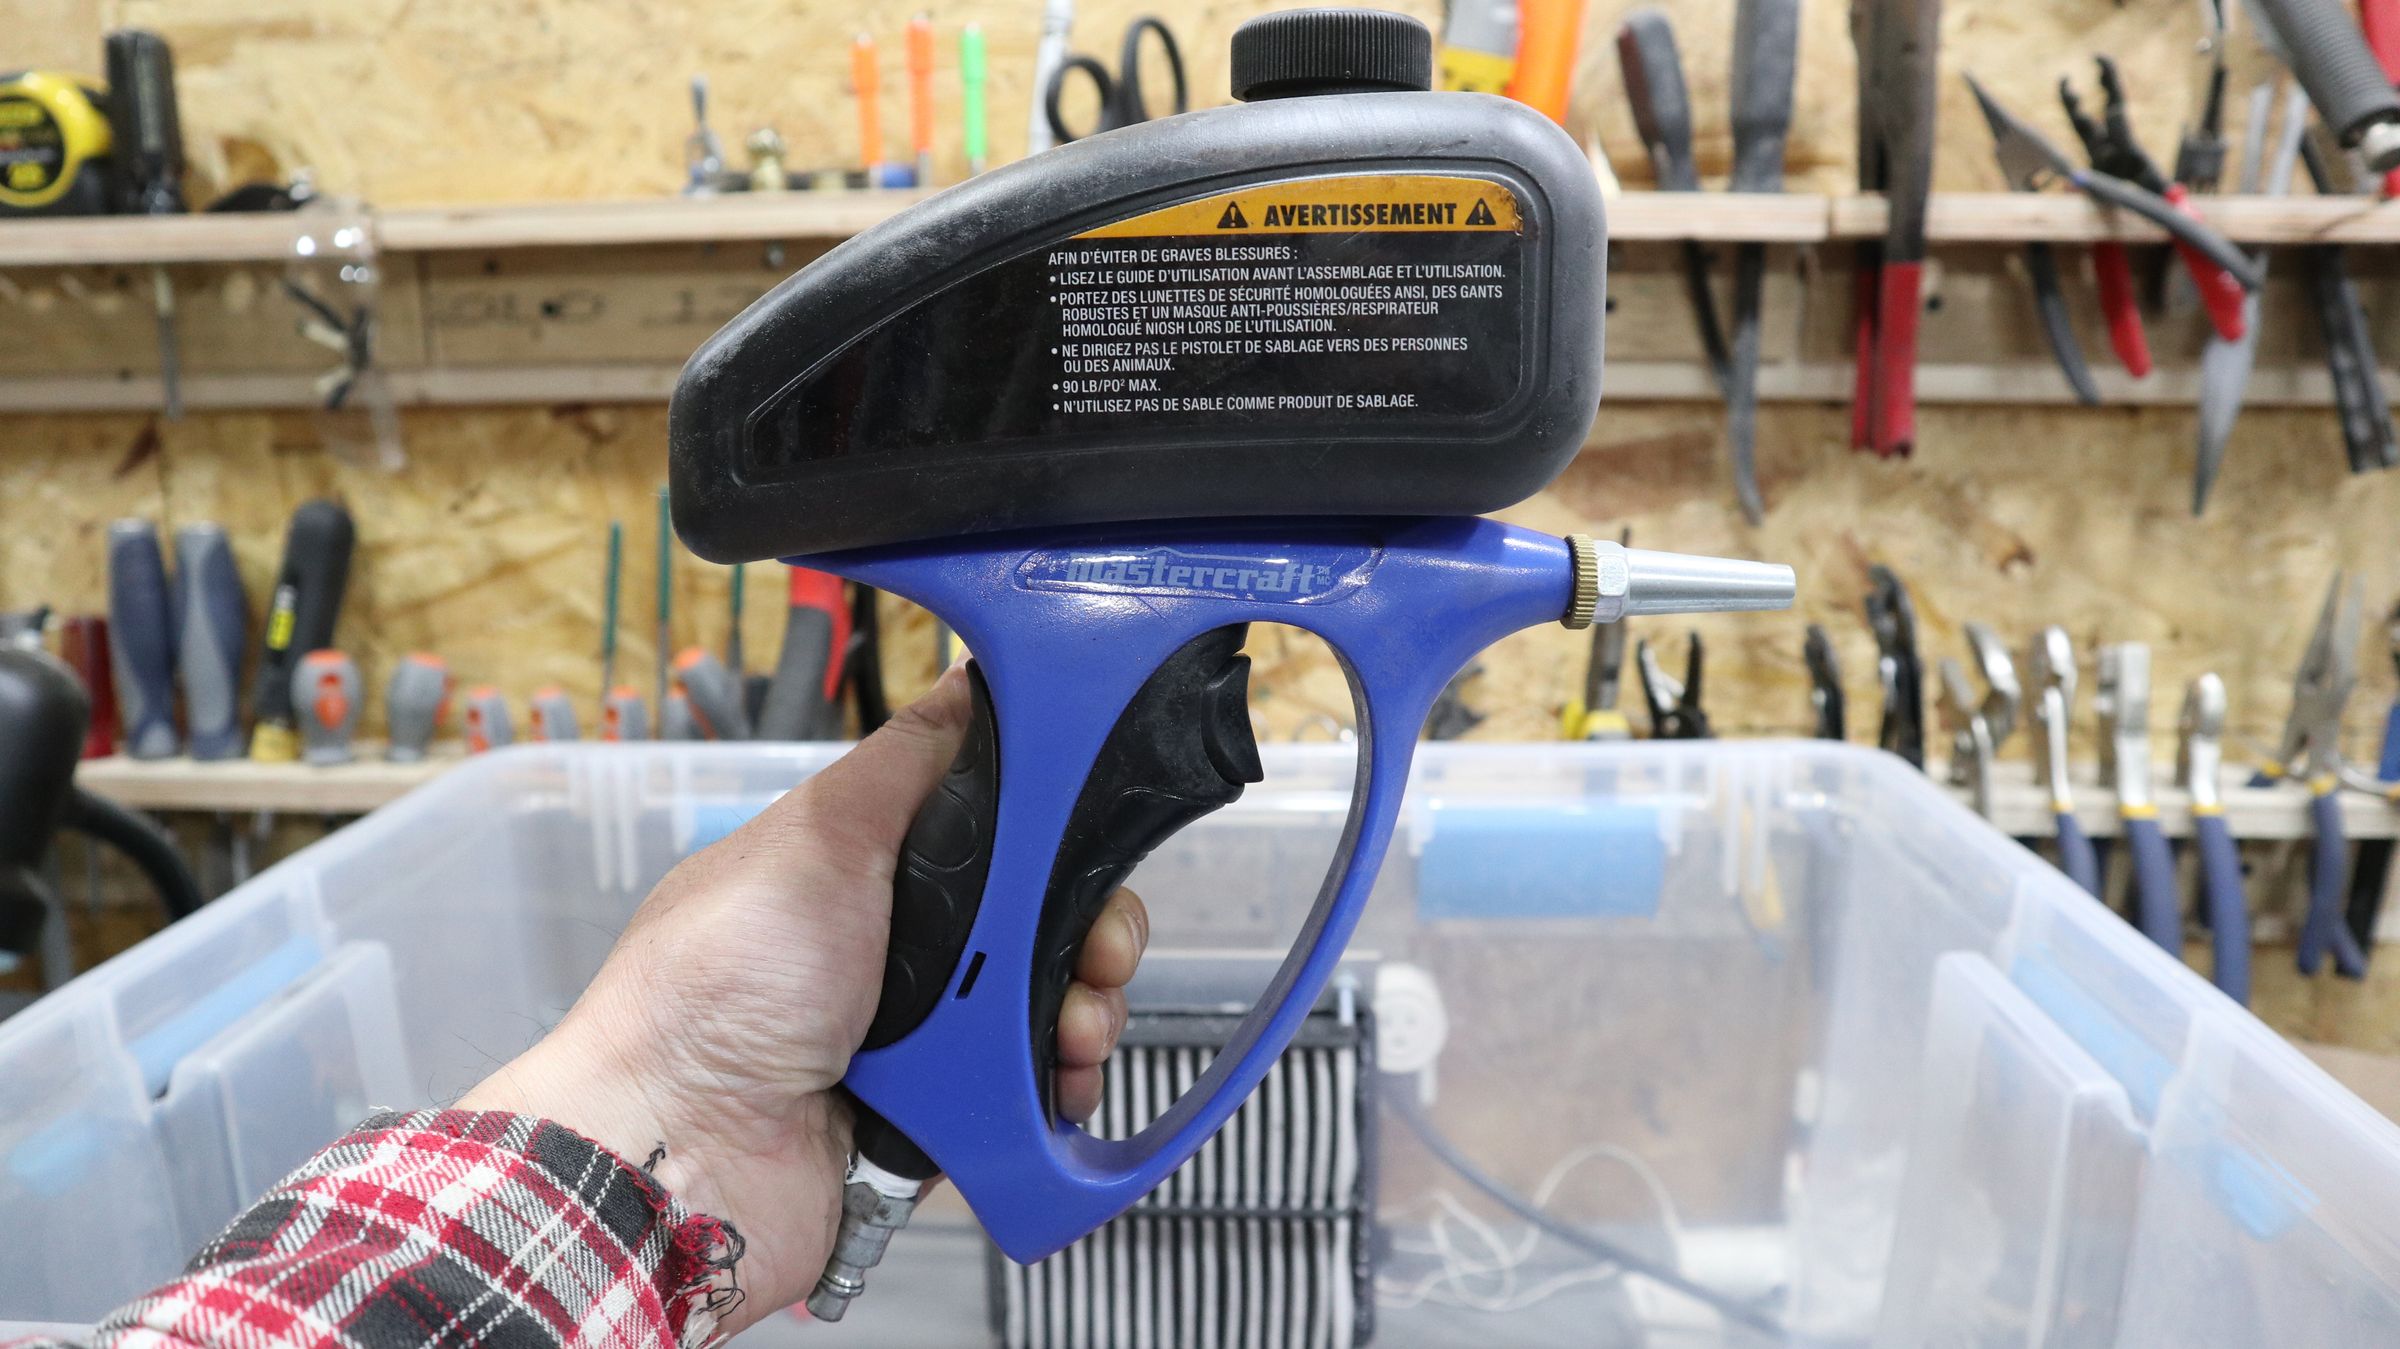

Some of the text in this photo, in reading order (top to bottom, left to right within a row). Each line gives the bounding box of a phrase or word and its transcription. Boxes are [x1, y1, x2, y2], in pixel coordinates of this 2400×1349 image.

[1264, 203, 1457, 226] AVERTISSEMENT
[1049, 252, 1077, 265] AFIN
[1081, 249, 1137, 264] D'ÉVITER
[1142, 250, 1157, 262] DE
[1162, 248, 1211, 262] GRAVES
[1216, 247, 1290, 260] BLESSURES
[1061, 265, 1505, 285] LISEZ LE GUIDE D'UTILISATION AVANT L'ASSEMBLAGE ET L'UTILISATION.
[1060, 283, 1502, 305] PORTEZ DES LUNETTES DE SÉCURITÉ HOMOLOGUÉES ANSI, DES GANTS
[1063, 301, 1438, 321] ROBUSTES ET UN MASQUE ANTI-POUSSIÈRES/RESPIRATEUR
[1063, 319, 1336, 336] HOMOLOGUÉ NIOSH LORS DE L'UTILISATION.
[1063, 338, 1467, 357] NE DIRIGEZ PAS LE PISTOLET DE SABLAGE VERS DES PERSONNES
[1064, 358, 1174, 372] OU DES ANIMAUX.
[1063, 381, 1078, 393] 90
[1129, 379, 1160, 391] MAX.
[1064, 394, 1418, 413] N'UTILISEZ PAS DE SABLE COMME PRODUIT DE SABLAGE.
